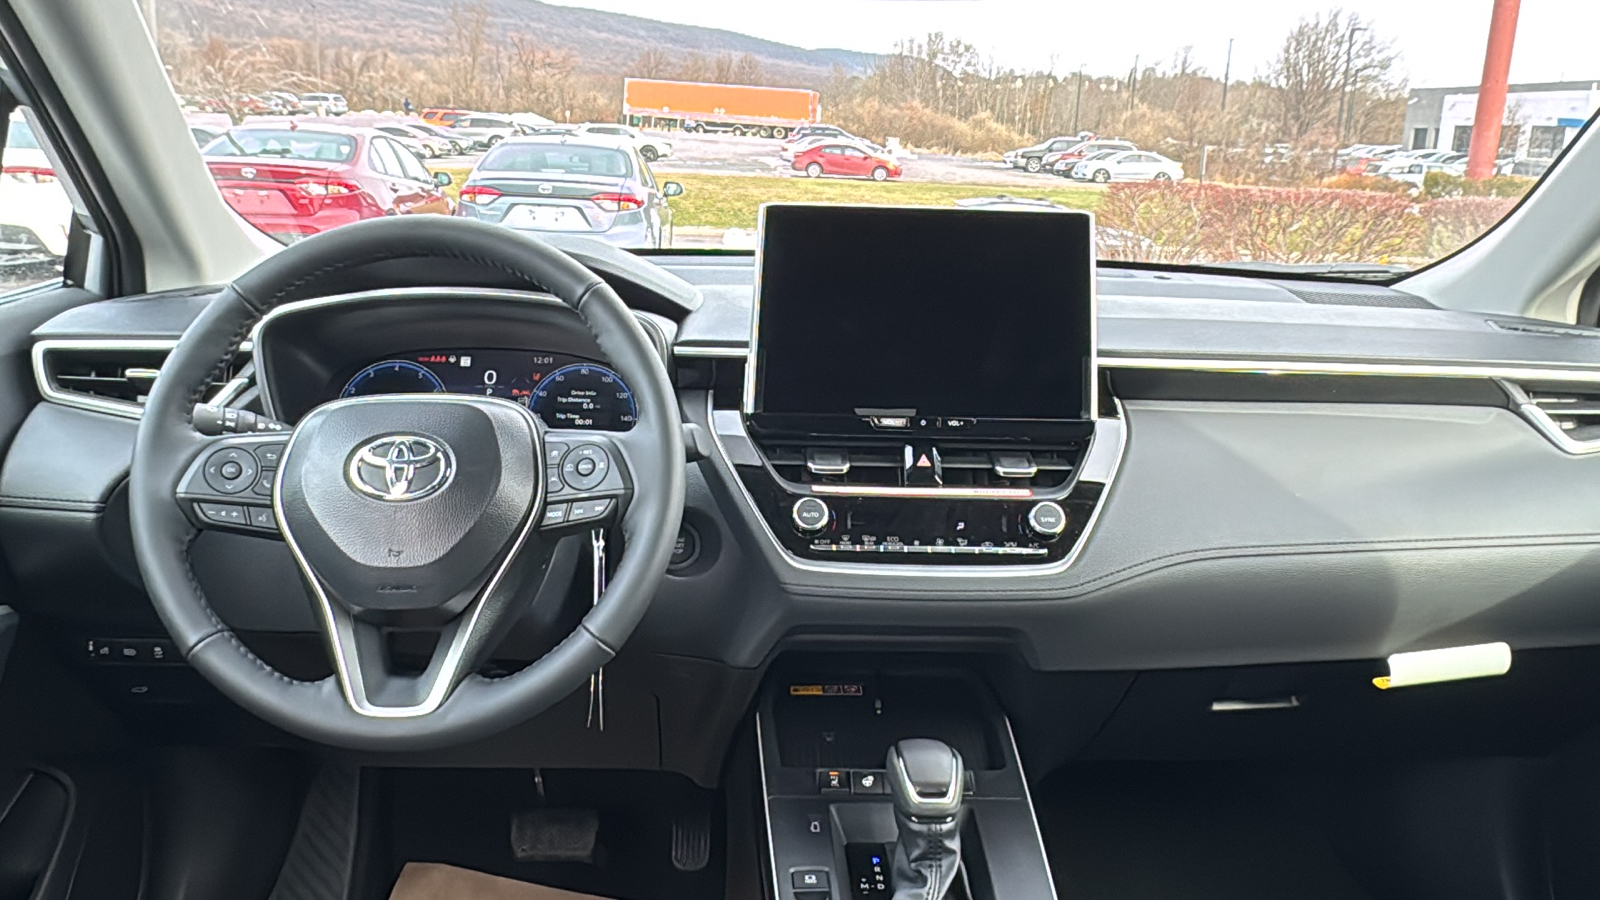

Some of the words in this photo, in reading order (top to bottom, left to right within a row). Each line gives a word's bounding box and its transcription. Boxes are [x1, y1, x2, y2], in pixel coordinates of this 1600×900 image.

[484, 370, 497, 385] 0
[486, 388, 493, 396] P
[546, 510, 562, 518] MODE
